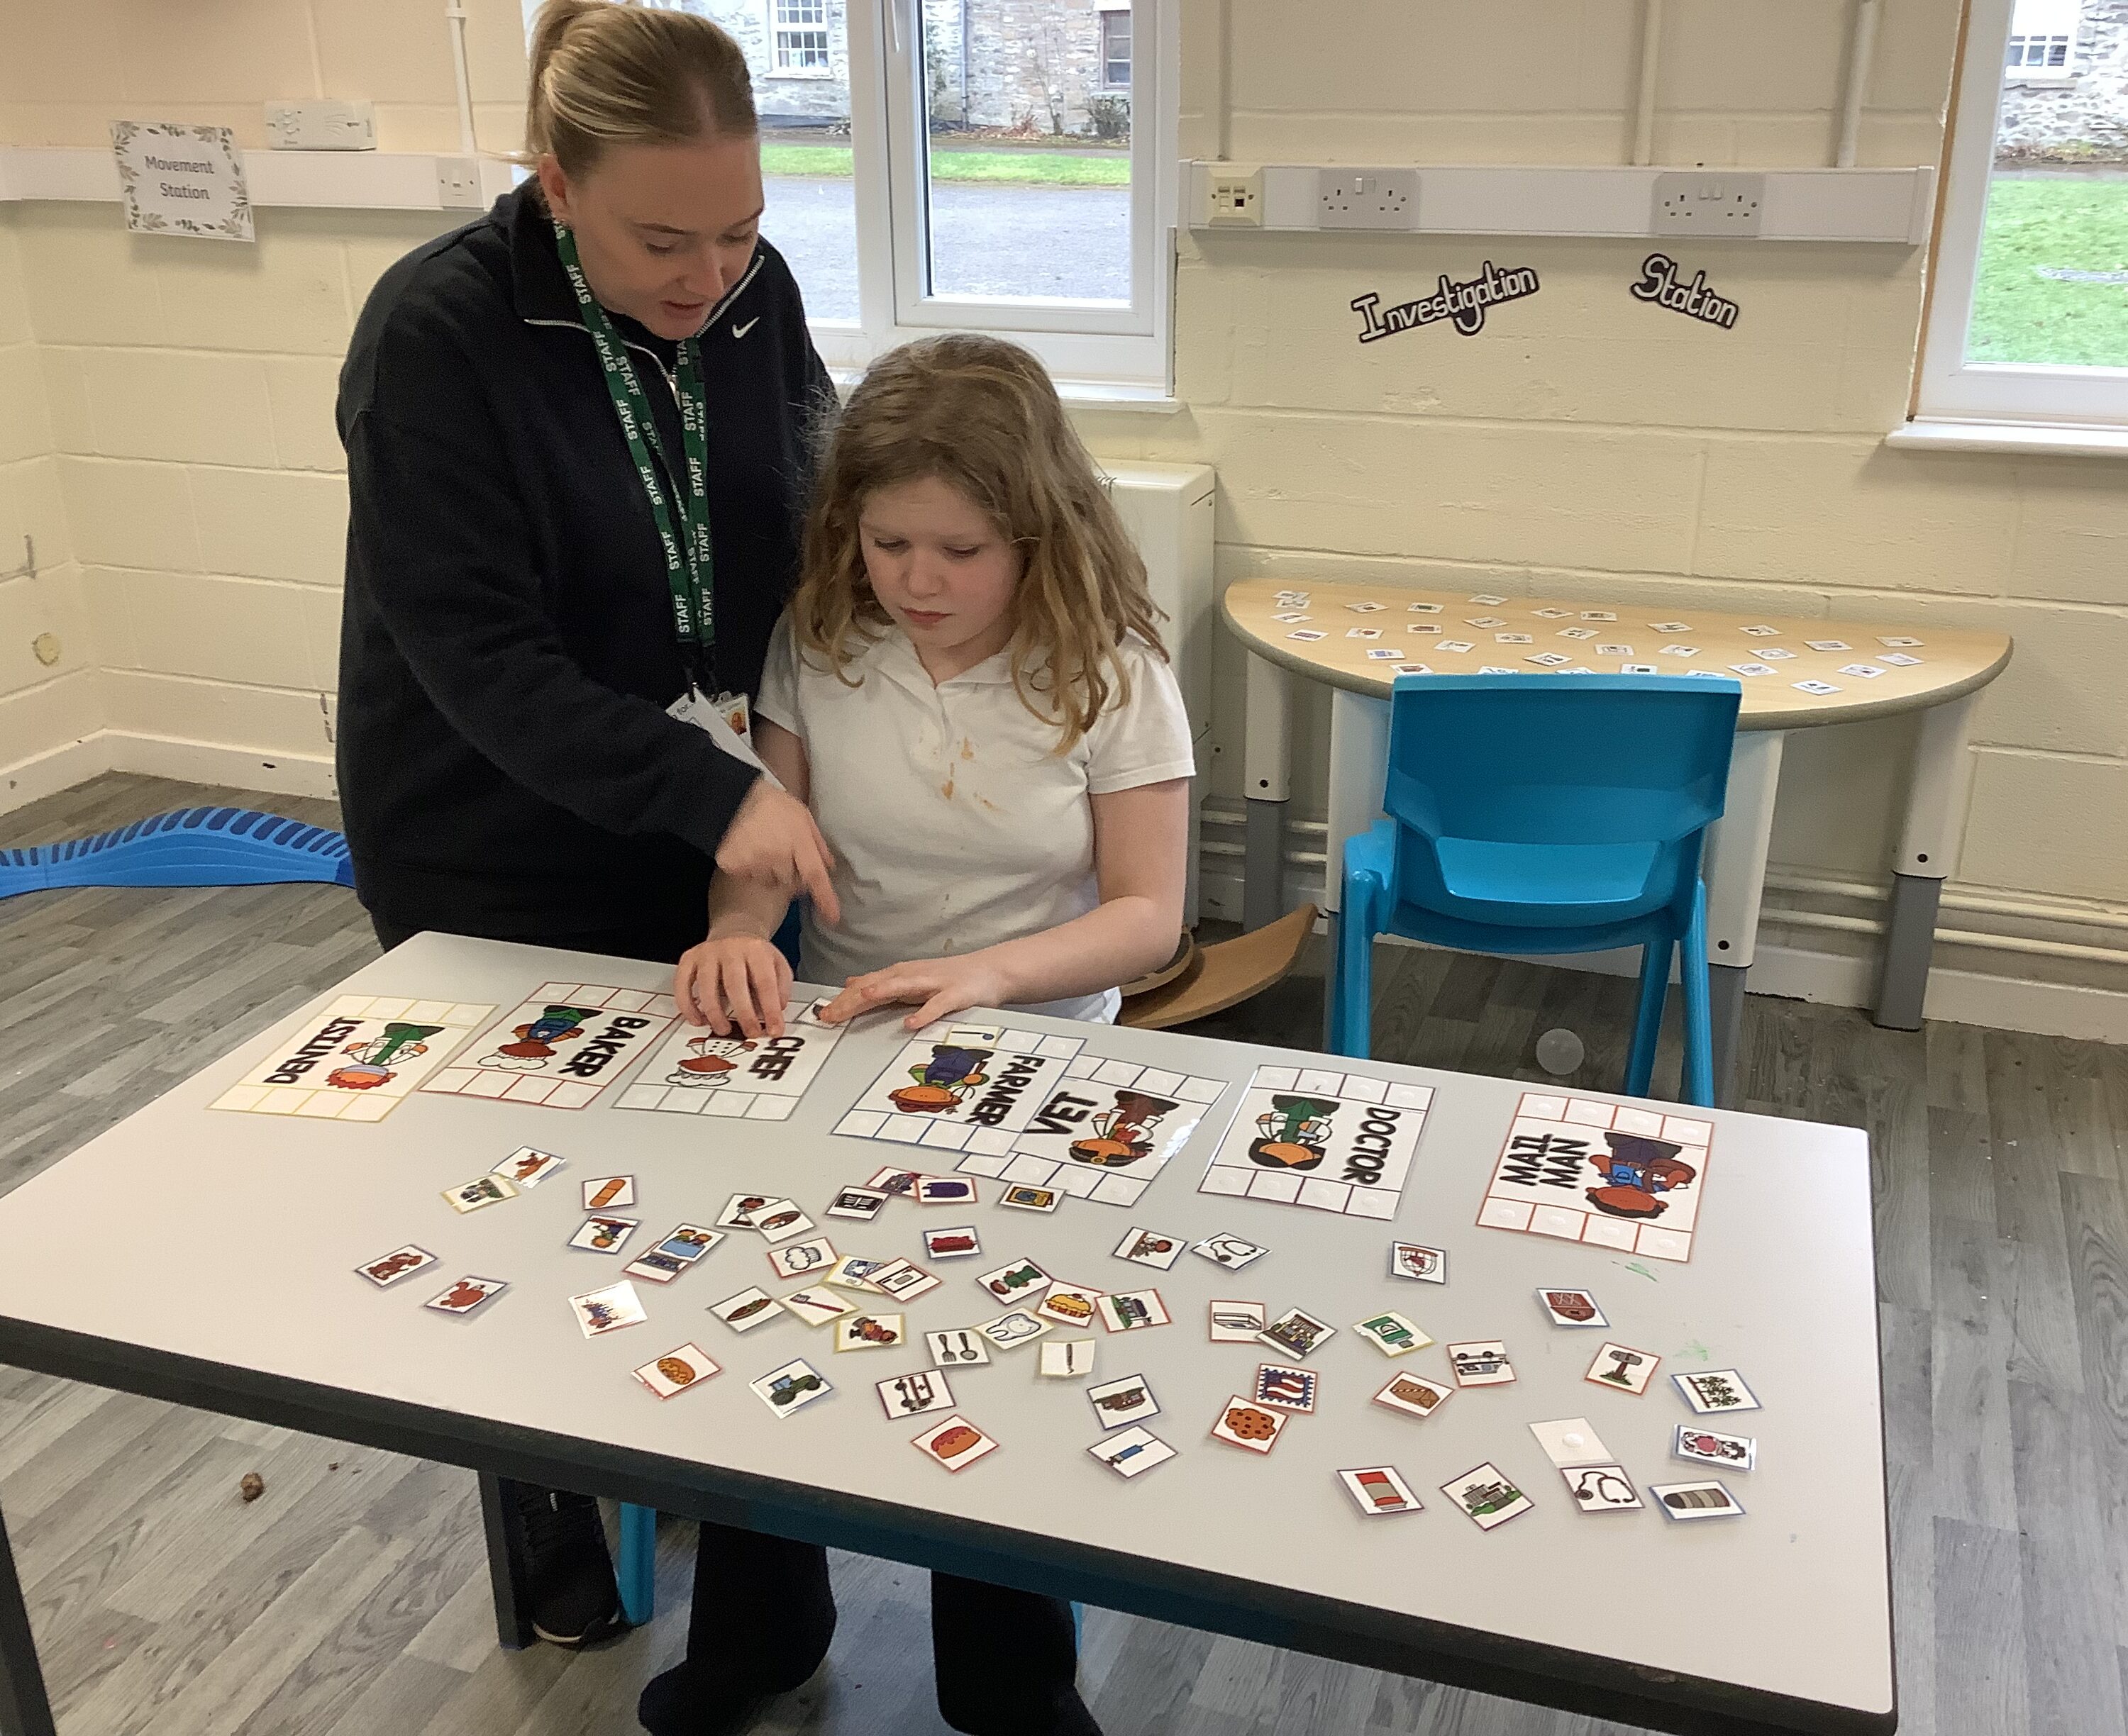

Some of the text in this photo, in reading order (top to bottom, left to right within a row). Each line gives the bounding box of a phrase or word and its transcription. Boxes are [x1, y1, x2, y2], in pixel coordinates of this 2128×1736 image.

[144, 155, 214, 174] Movement
[160, 182, 210, 199] Station
[565, 265, 592, 304] STAFF
[1351, 255, 1739, 342] Investigation Station
[593, 331, 618, 372] STAFF
[676, 340, 689, 365] STA
[616, 356, 641, 396] STAFF
[616, 399, 638, 440] STAFF
[681, 392, 697, 431] STAFF
[640, 466, 663, 505] STAFF
[689, 457, 704, 496] STAFF
[661, 531, 680, 570] STAFF
[697, 523, 710, 562] STAFF
[675, 594, 690, 633] STAFF
[702, 588, 712, 625] STAFF
[262, 1017, 365, 1084] DENTIST
[558, 1017, 650, 1077] BAKER
[748, 1036, 805, 1081] CHEF
[964, 1055, 1046, 1126] FARMER
[1022, 1091, 1098, 1135] VET
[1340, 1107, 1402, 1185] DOCTOR
[1499, 1133, 1553, 1186] MAIL
[1539, 1137, 1591, 1189] MAN
